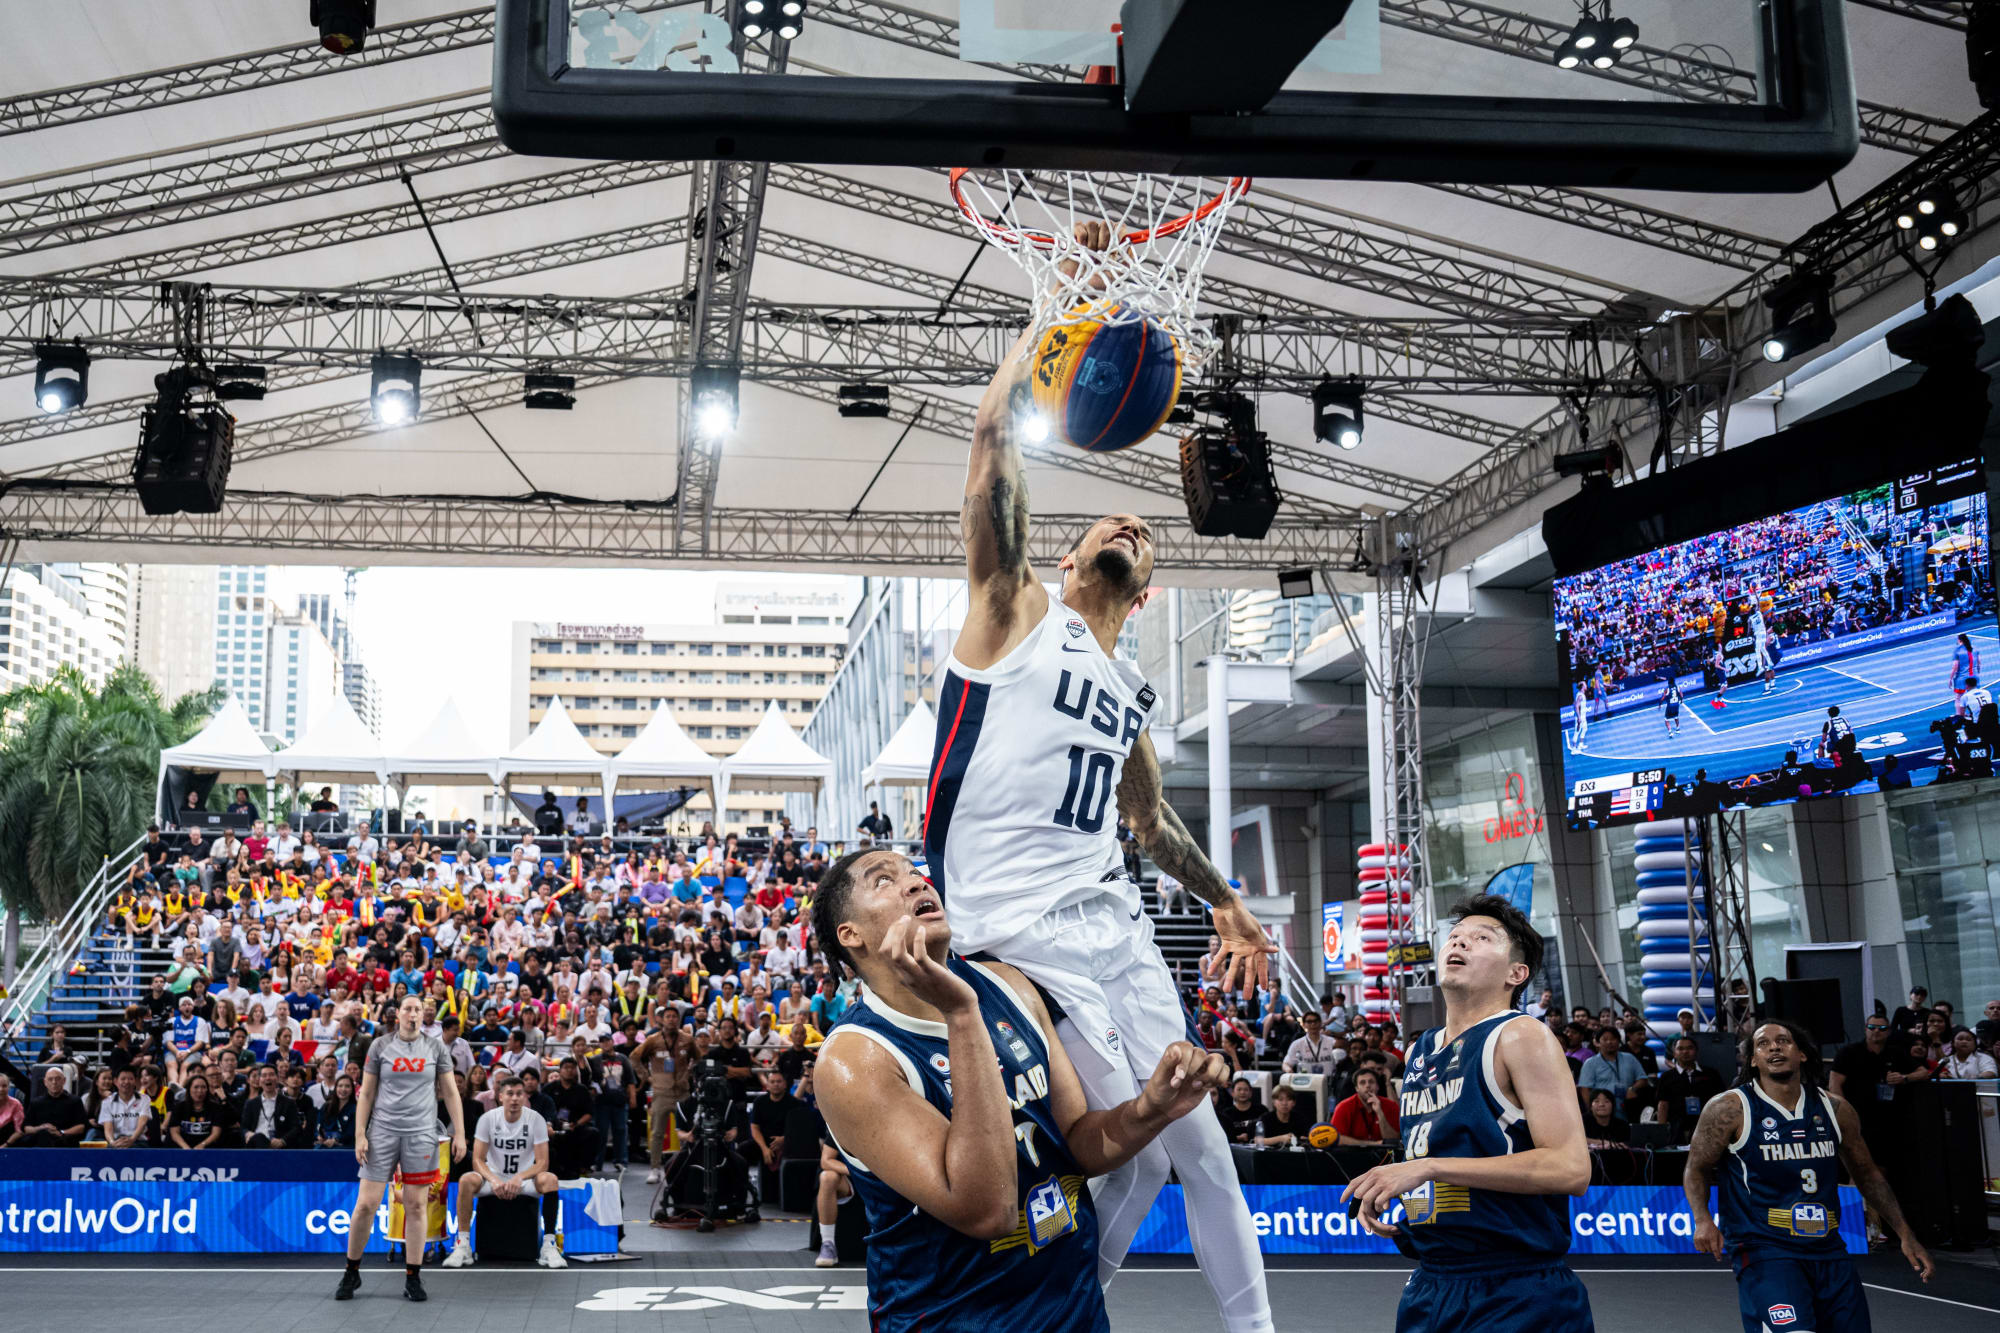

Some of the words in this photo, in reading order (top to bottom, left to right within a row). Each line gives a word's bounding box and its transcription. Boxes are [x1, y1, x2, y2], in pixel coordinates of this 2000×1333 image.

[1140, 690, 1155, 702] FIBA
[1053, 669, 1143, 746] USA
[1637, 769, 1662, 784] 5:50
[1052, 744, 1115, 833] 10
[1635, 789, 1644, 797] 12
[1578, 796, 1594, 806] USA
[1635, 801, 1641, 810] 9
[1577, 808, 1593, 818] THA
[1400, 1076, 1464, 1117] THAILAND
[494, 1138, 527, 1150] USA
[1405, 1120, 1433, 1160] 18
[1759, 1140, 1835, 1161] THAILAND
[503, 1154, 520, 1174] 15
[1800, 1168, 1818, 1193] 3
[1770, 1309, 1793, 1320] TOA
